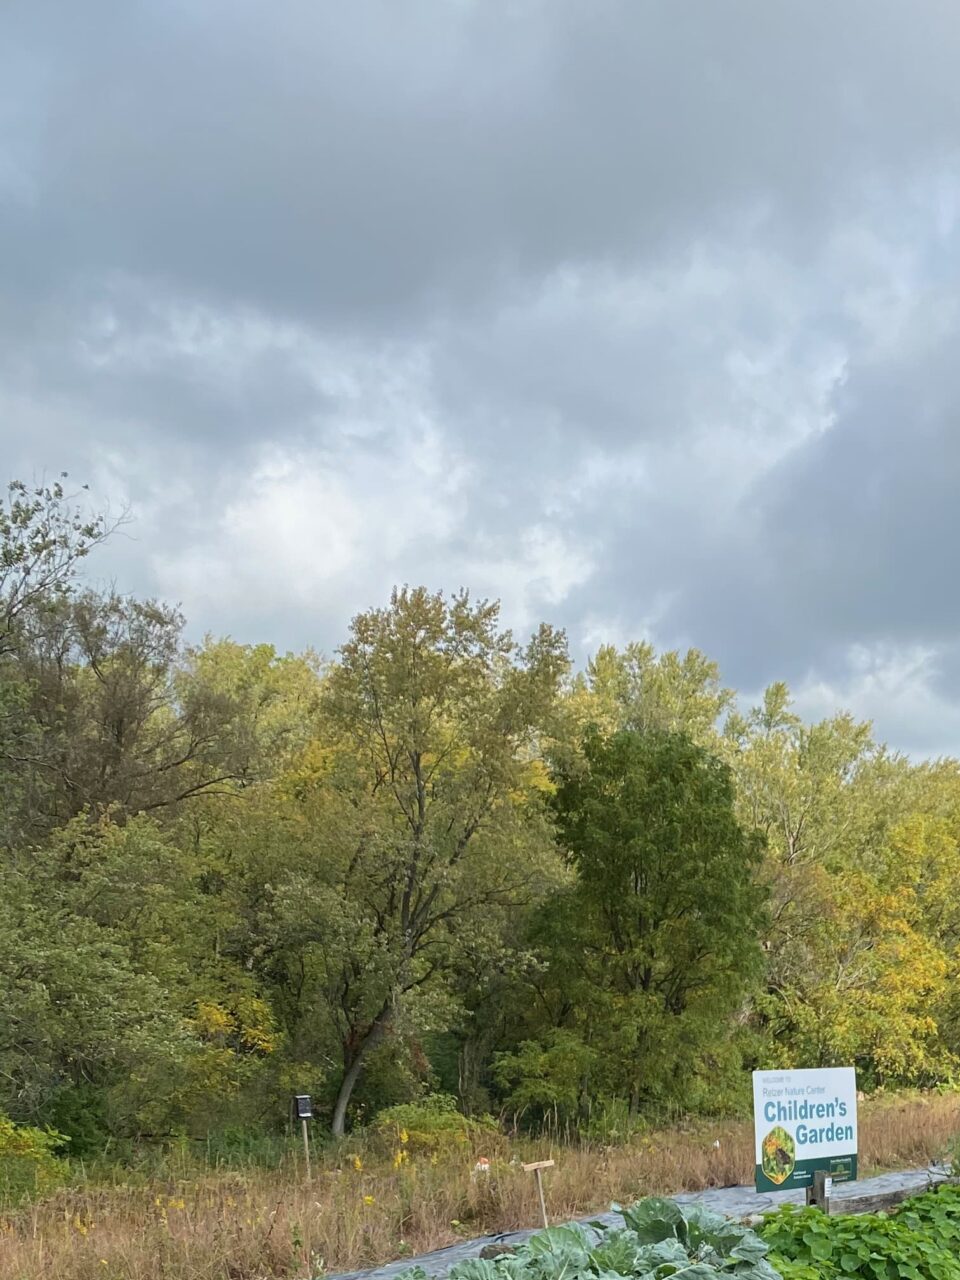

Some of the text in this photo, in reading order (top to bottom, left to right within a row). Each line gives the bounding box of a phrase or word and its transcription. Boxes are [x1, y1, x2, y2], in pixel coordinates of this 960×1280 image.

[785, 1087, 805, 1096] Nature
[806, 1085, 825, 1095] Center
[764, 1097, 847, 1122] Children's
[796, 1122, 853, 1145] Garden
